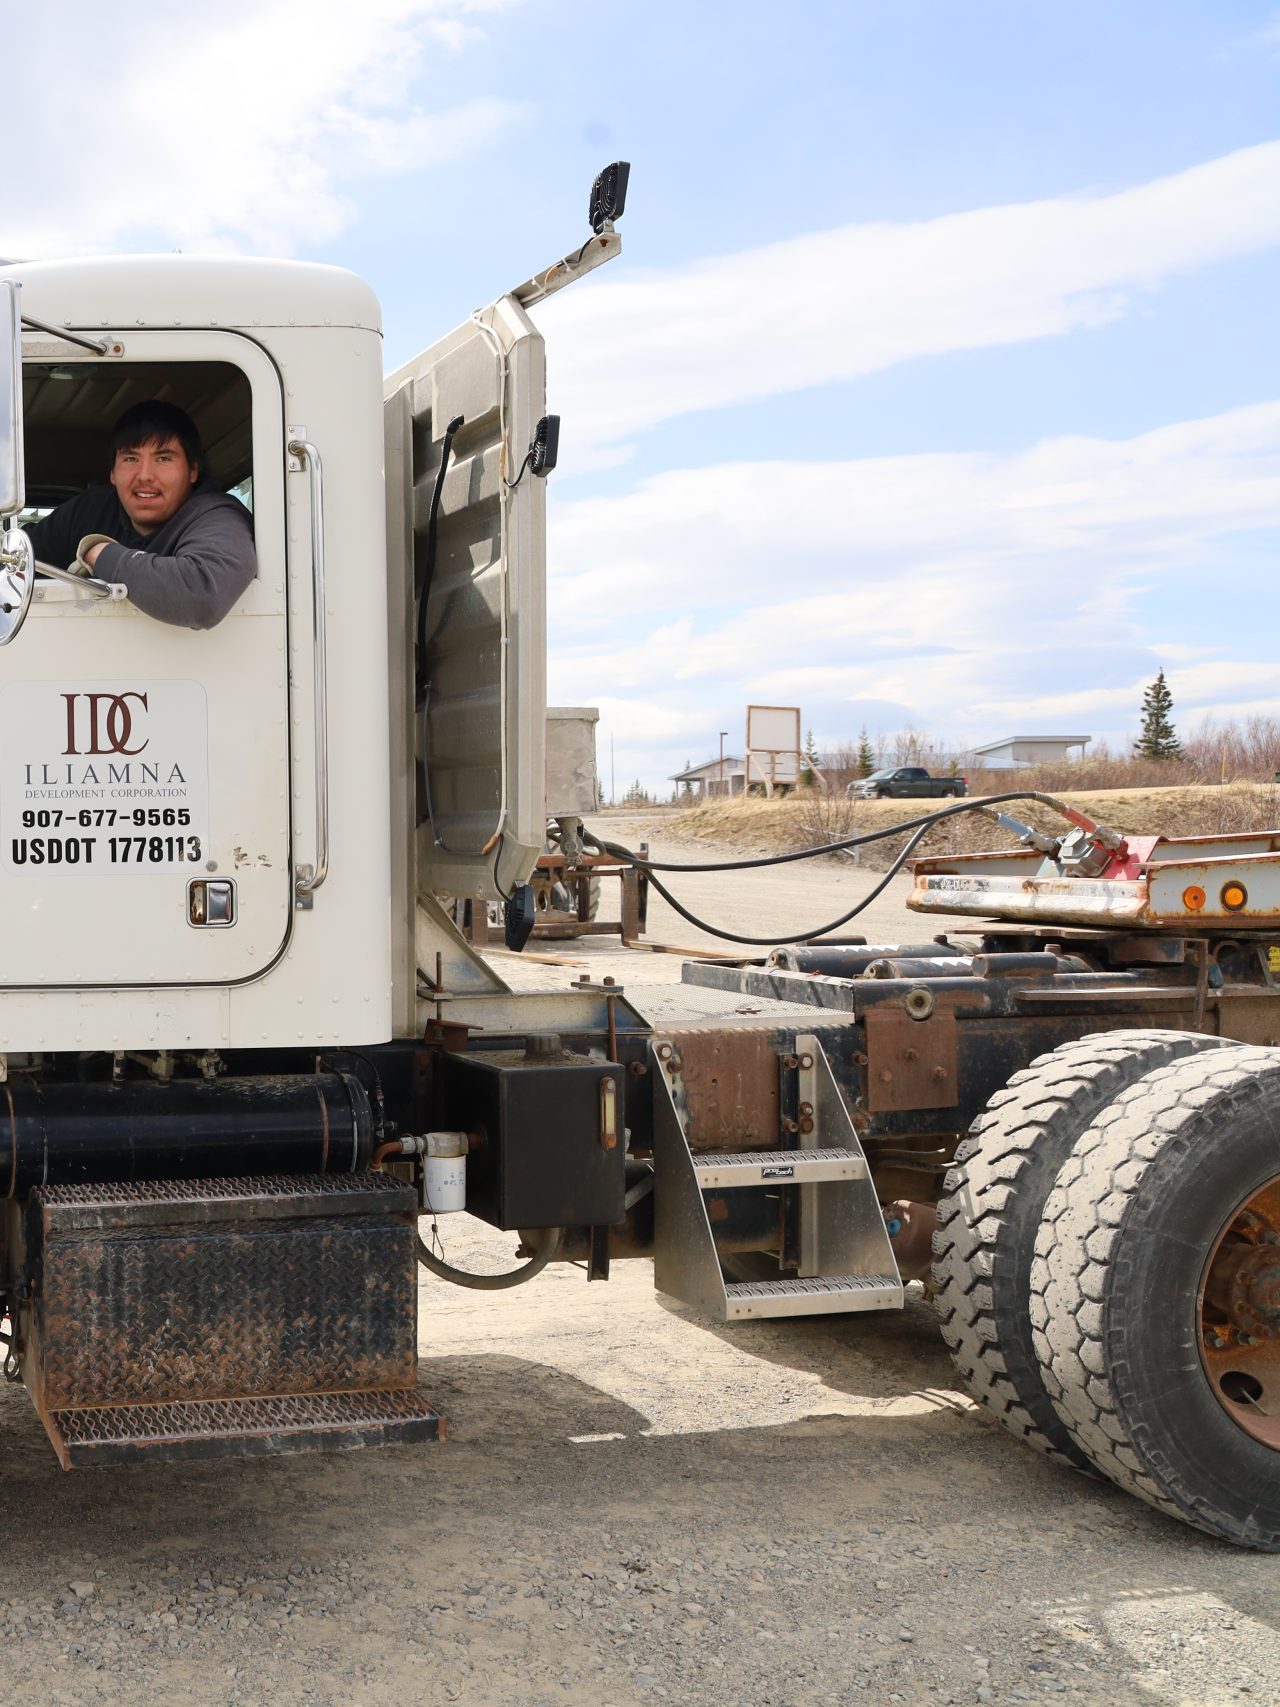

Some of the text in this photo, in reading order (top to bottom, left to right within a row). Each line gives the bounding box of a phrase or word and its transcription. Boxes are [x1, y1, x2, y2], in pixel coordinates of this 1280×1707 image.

[60, 691, 150, 756] IDC
[24, 762, 187, 785] ILIAMNA
[24, 788, 187, 799] DEVELOPMENT CORPORATION
[22, 808, 191, 828] 907-677-9565
[12, 836, 202, 864] USDOT 1778113
